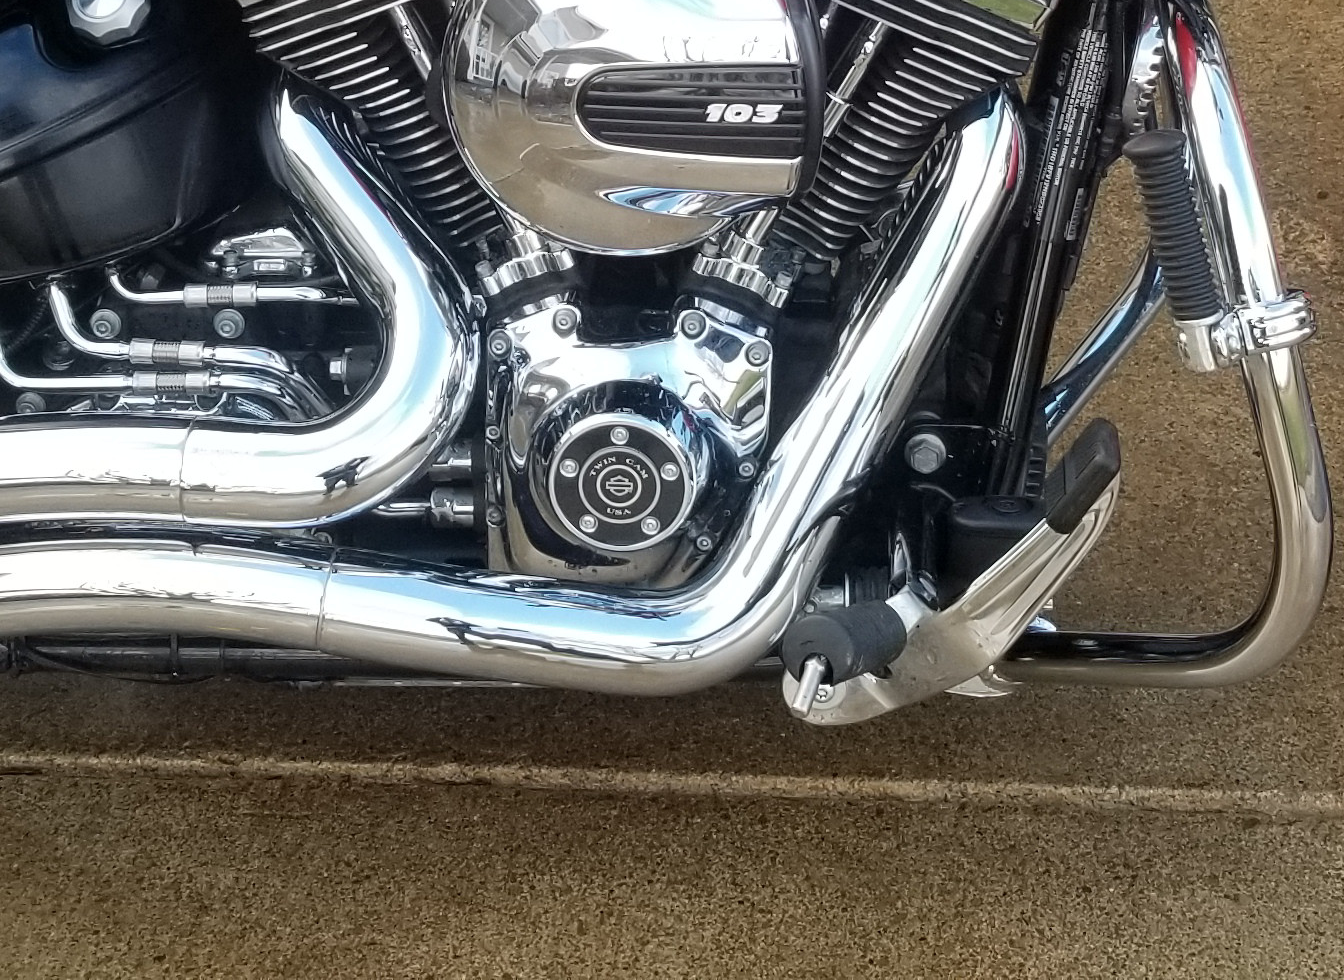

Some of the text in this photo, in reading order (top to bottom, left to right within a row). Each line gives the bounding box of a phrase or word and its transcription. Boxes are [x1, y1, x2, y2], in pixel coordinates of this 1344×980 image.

[704, 103, 784, 123] 103
[589, 456, 649, 479] TWIN CAM
[606, 507, 632, 516] USA
